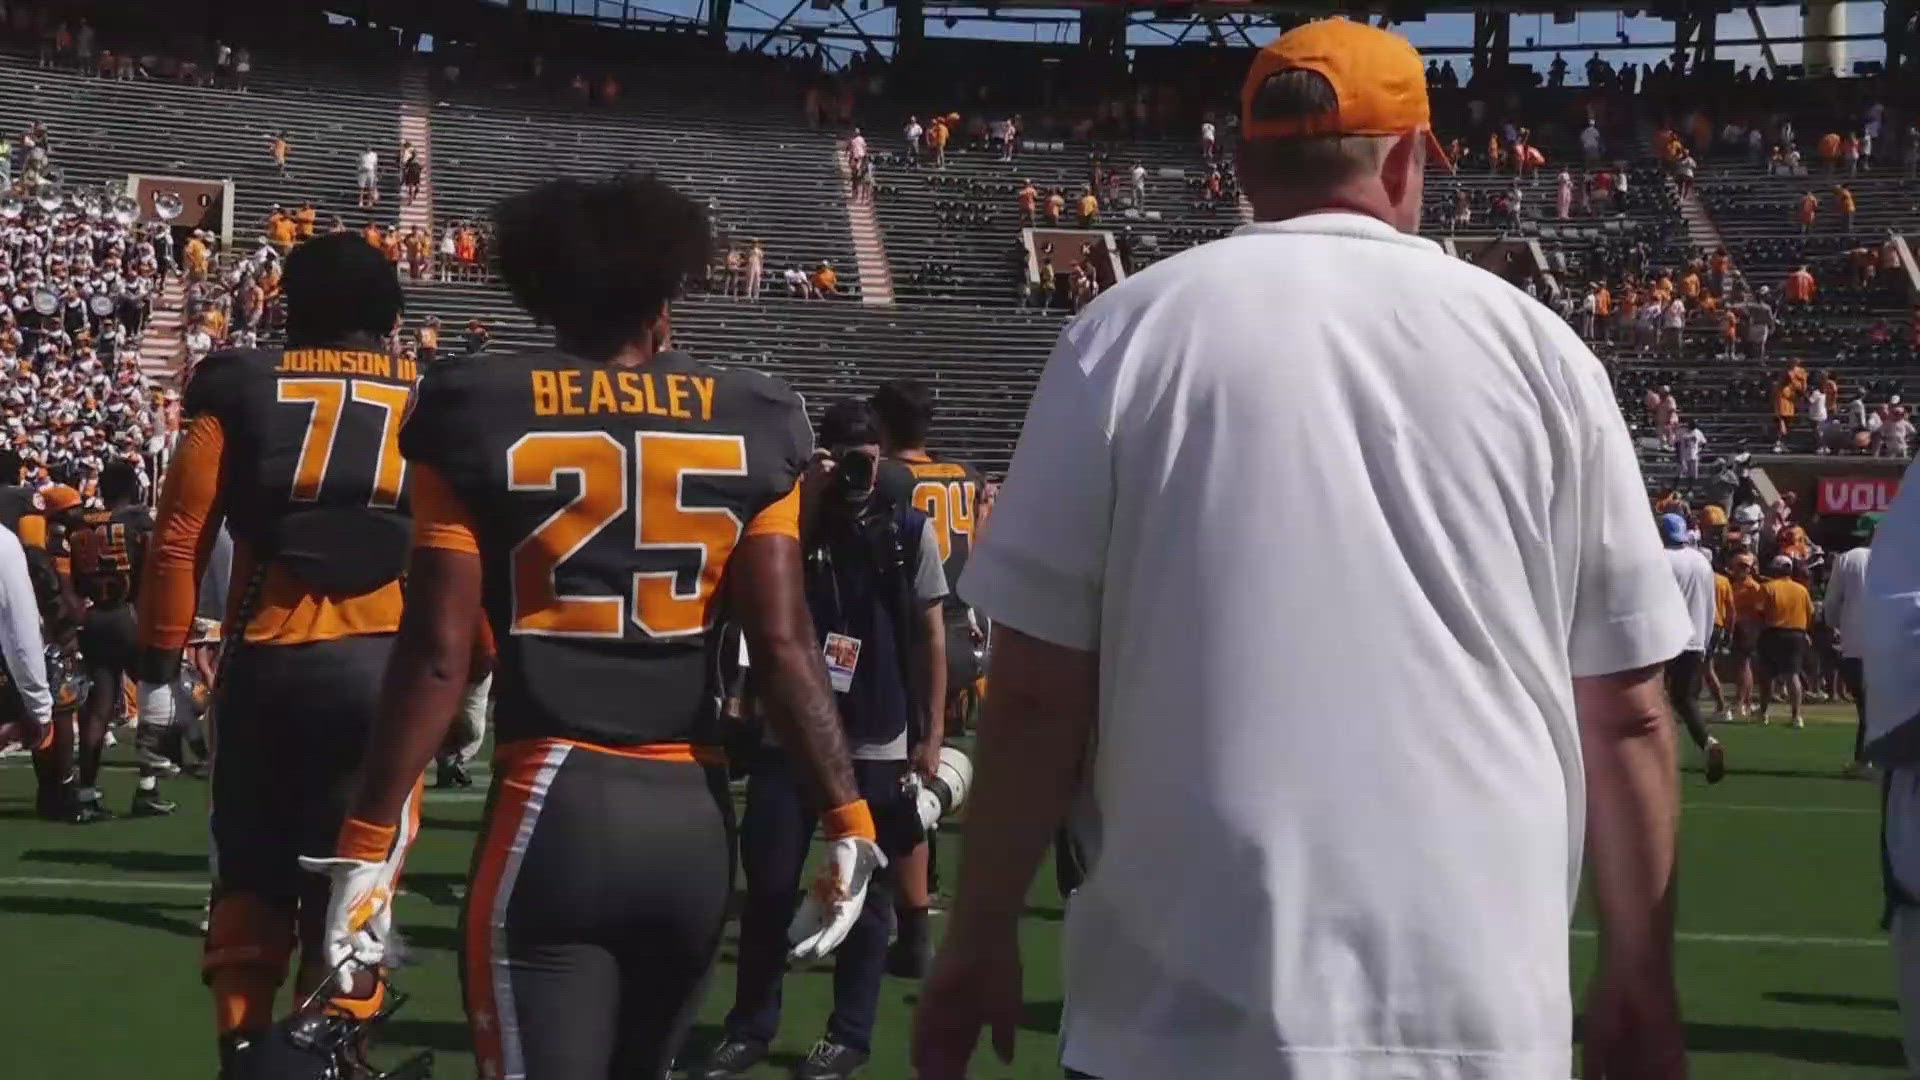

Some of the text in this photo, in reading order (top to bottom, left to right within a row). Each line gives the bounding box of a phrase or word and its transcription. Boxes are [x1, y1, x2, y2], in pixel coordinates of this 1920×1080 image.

[274, 349, 417, 382] JOHNSON III
[530, 369, 716, 421] BEASLEY
[276, 377, 411, 508] 77
[506, 431, 748, 638] 25
